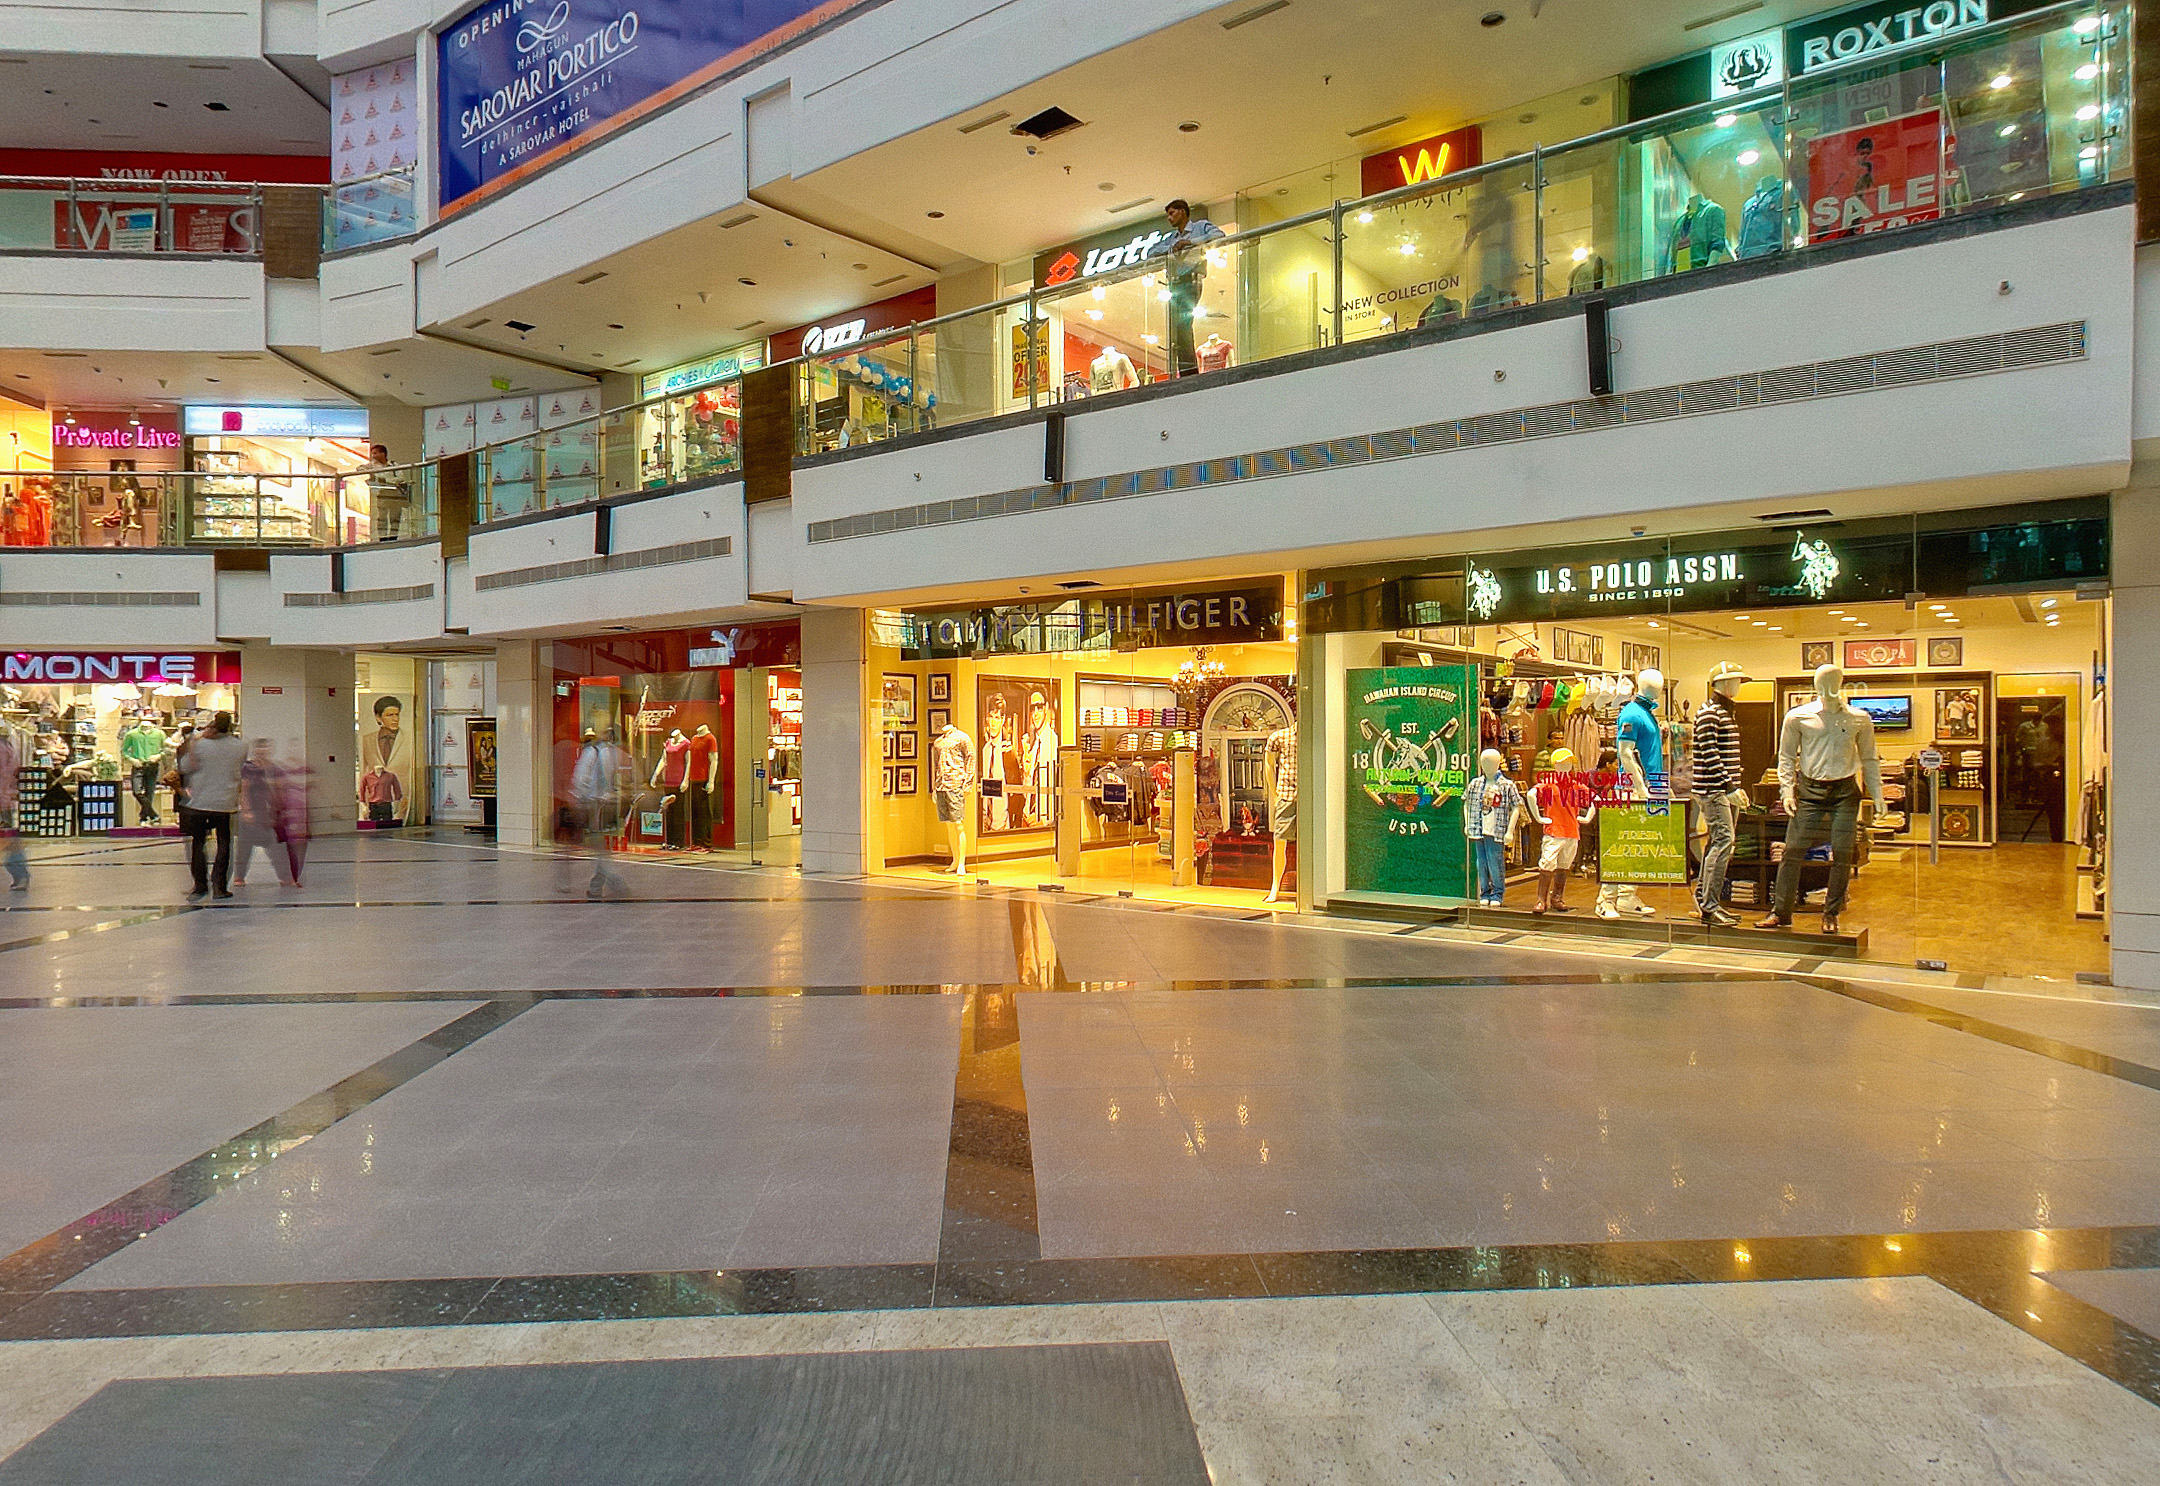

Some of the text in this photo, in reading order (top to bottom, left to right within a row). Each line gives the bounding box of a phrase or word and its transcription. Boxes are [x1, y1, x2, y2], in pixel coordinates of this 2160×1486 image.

[459, 0, 535, 48] OPENIN
[1803, 0, 1988, 70] ROXTON
[517, 31, 569, 71] MAHAGUN
[460, 11, 639, 139] SAROVAR PORTICO
[552, 71, 613, 114] vaishali
[499, 107, 590, 165] A SAROVAR HOTEL
[100, 168, 155, 180] NOW
[1398, 142, 1450, 186] W
[1812, 173, 1936, 230] SALE
[1082, 230, 1172, 277] lott
[1345, 275, 1460, 312] NEW COLLECTION
[1345, 309, 1376, 322] IN STORE
[1536, 553, 1745, 594] U.S. POLO ASSN.
[1588, 587, 1685, 603] SINCE 1890
[917, 597, 1251, 648] TOMMY HILFIGER
[1400, 686, 1428, 697] ISLAND
[1401, 722, 1420, 734] EST.
[1352, 753, 1470, 771] 18 90
[1646, 771, 1669, 816] HUES
[1602, 844, 1683, 858] ARRIVAL
[1628, 871, 1647, 879] NOW
[1648, 871, 1657, 879] IN
